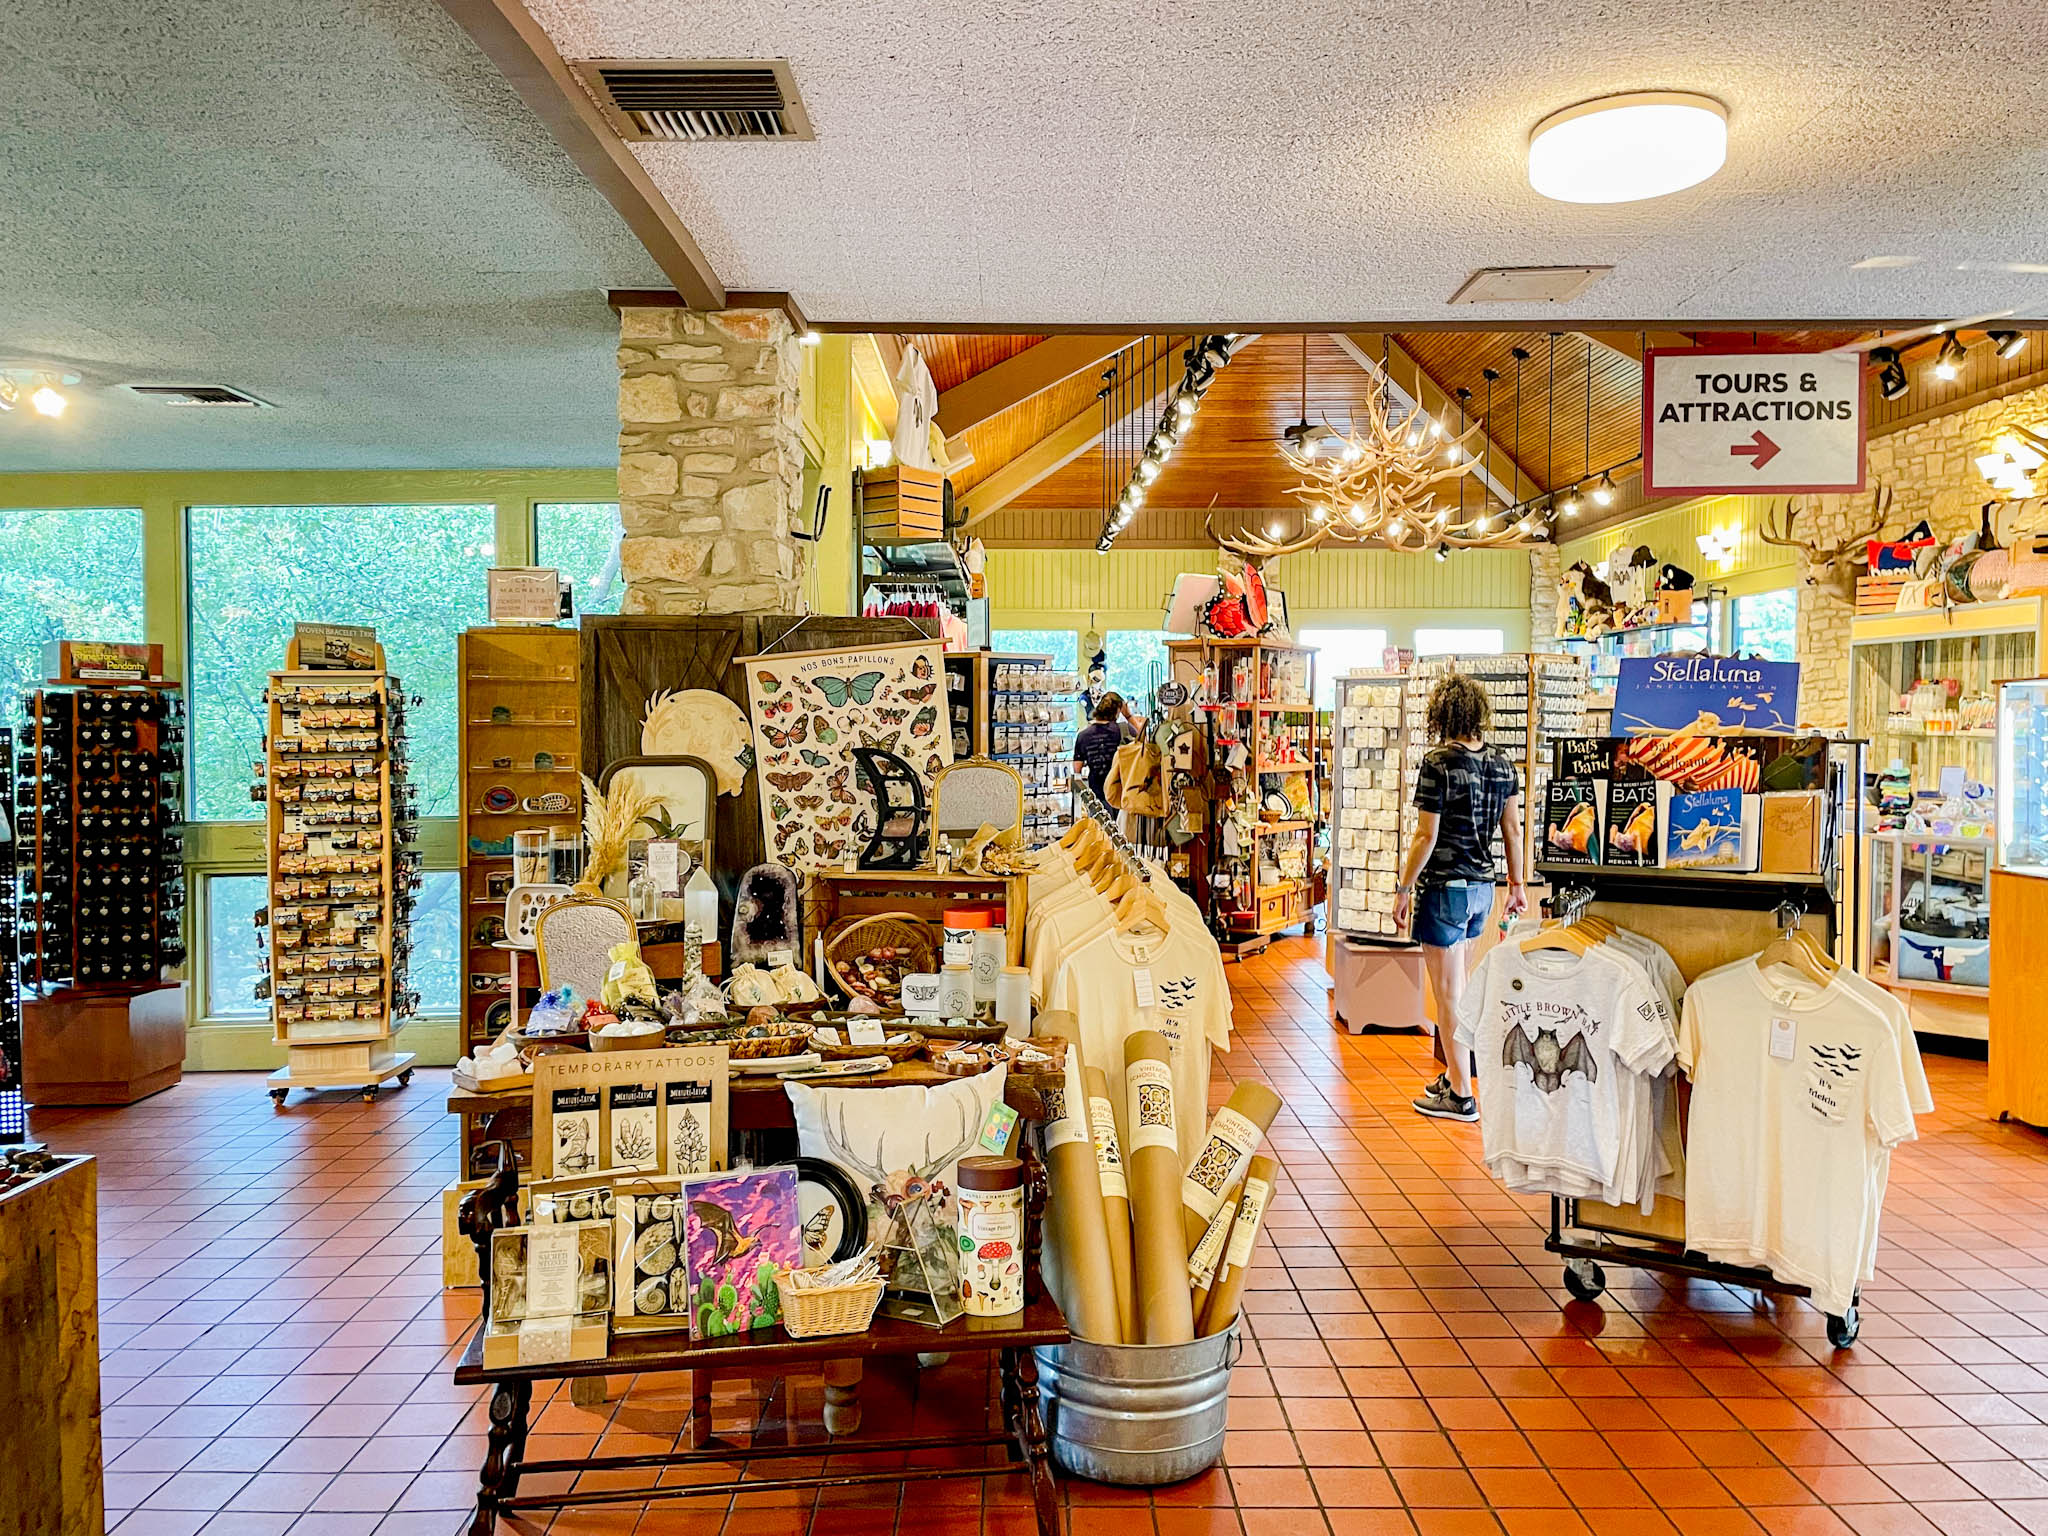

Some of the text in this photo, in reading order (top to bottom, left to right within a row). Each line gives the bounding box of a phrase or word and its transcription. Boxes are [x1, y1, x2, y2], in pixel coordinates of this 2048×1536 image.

[1696, 372, 1817, 393] TOURS &
[1658, 400, 1852, 423] ATTRACTIONS
[297, 625, 324, 635] WOVEN
[325, 628, 358, 637] BRACELET
[106, 661, 145, 671] Pendants
[800, 656, 895, 673] NOS BONS PAPILLONS
[1649, 659, 1762, 683] Stellaluna
[1566, 739, 1599, 755] Bats
[1572, 752, 1609, 773] Band
[1551, 786, 1594, 802] BATS
[1612, 787, 1655, 803] BATS
[1682, 794, 1729, 813] Stellaluna
[1501, 1002, 1532, 1023] LITTLE
[1536, 1001, 1580, 1020] BROWN
[1166, 1018, 1179, 1027] it's
[550, 1056, 716, 1076] TEMPORARY TATTOOS
[1819, 1078, 1832, 1090] it's
[1226, 1119, 1253, 1137] VINTAGE
[1198, 1219, 1223, 1250] VINTAGE
